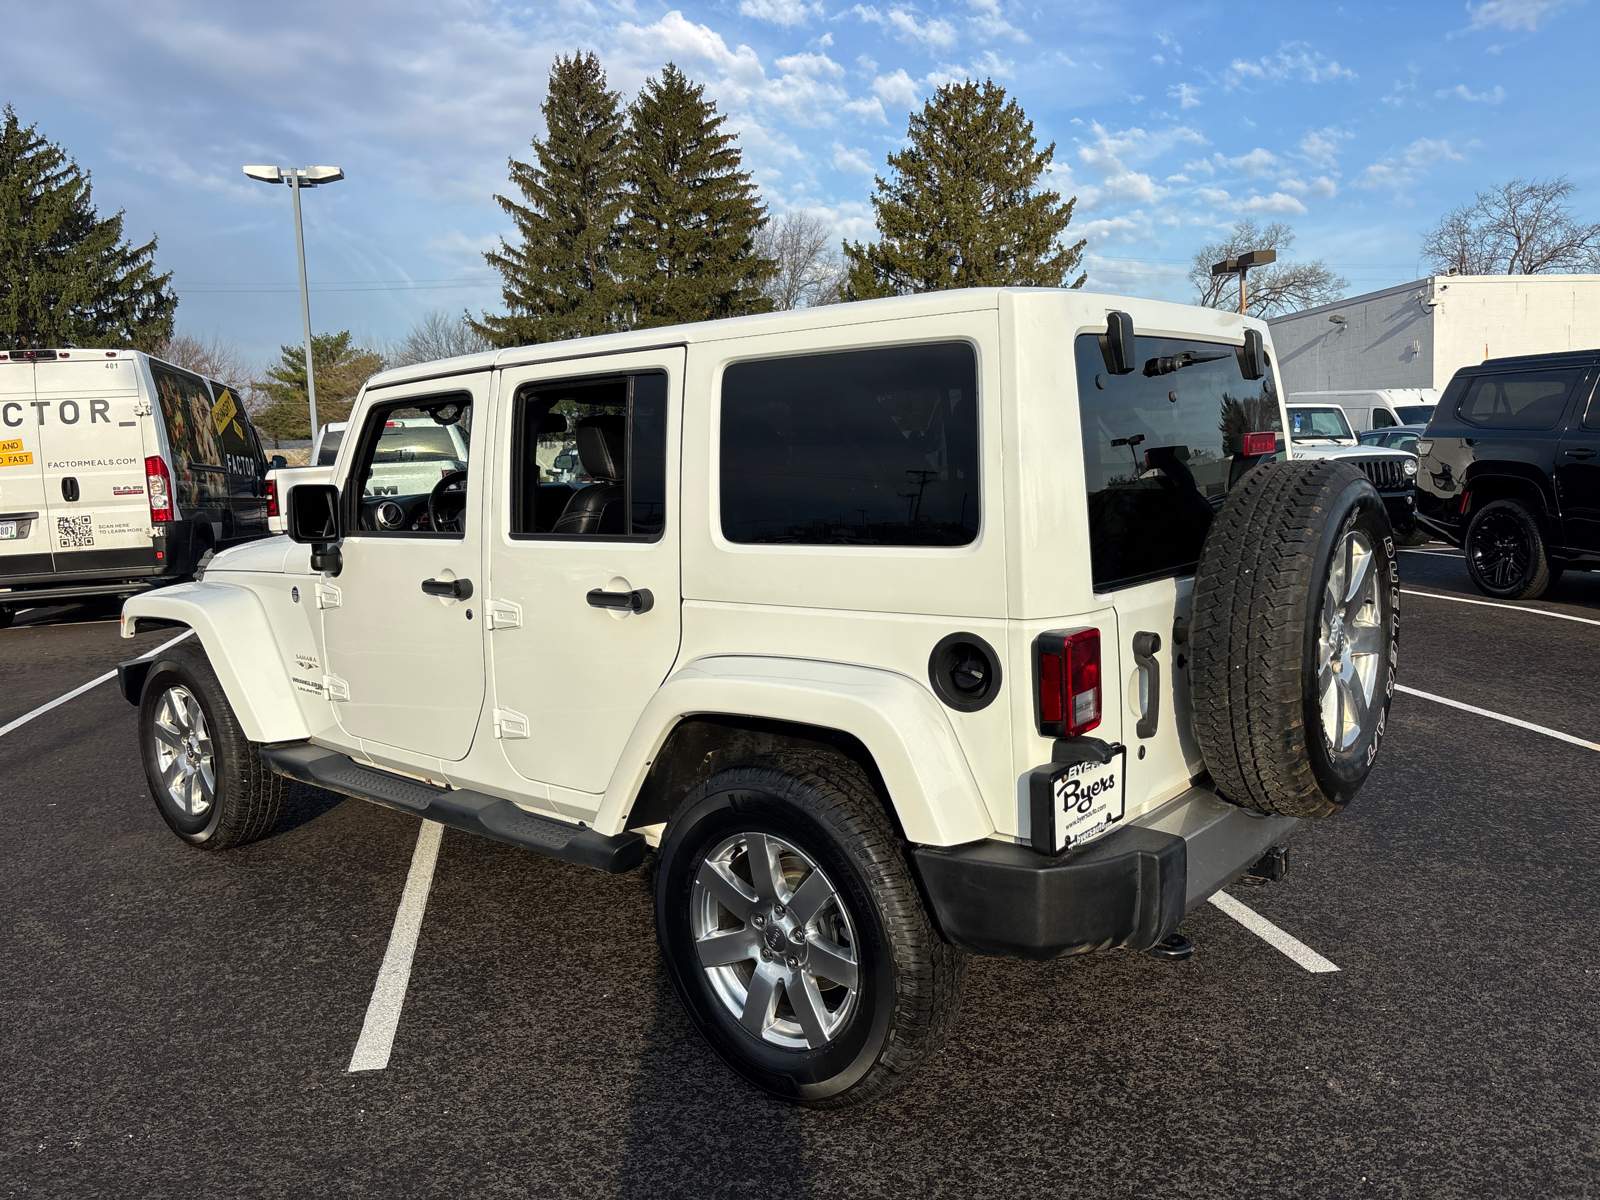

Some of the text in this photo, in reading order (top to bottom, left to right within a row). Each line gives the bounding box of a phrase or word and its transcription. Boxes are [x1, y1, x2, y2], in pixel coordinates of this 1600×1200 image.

[2, 442, 19, 451] AND
[8, 455, 29, 464] FAST
[47, 458, 137, 468] FACTORMEALS.COM
[1056, 774, 1115, 813] Byers
